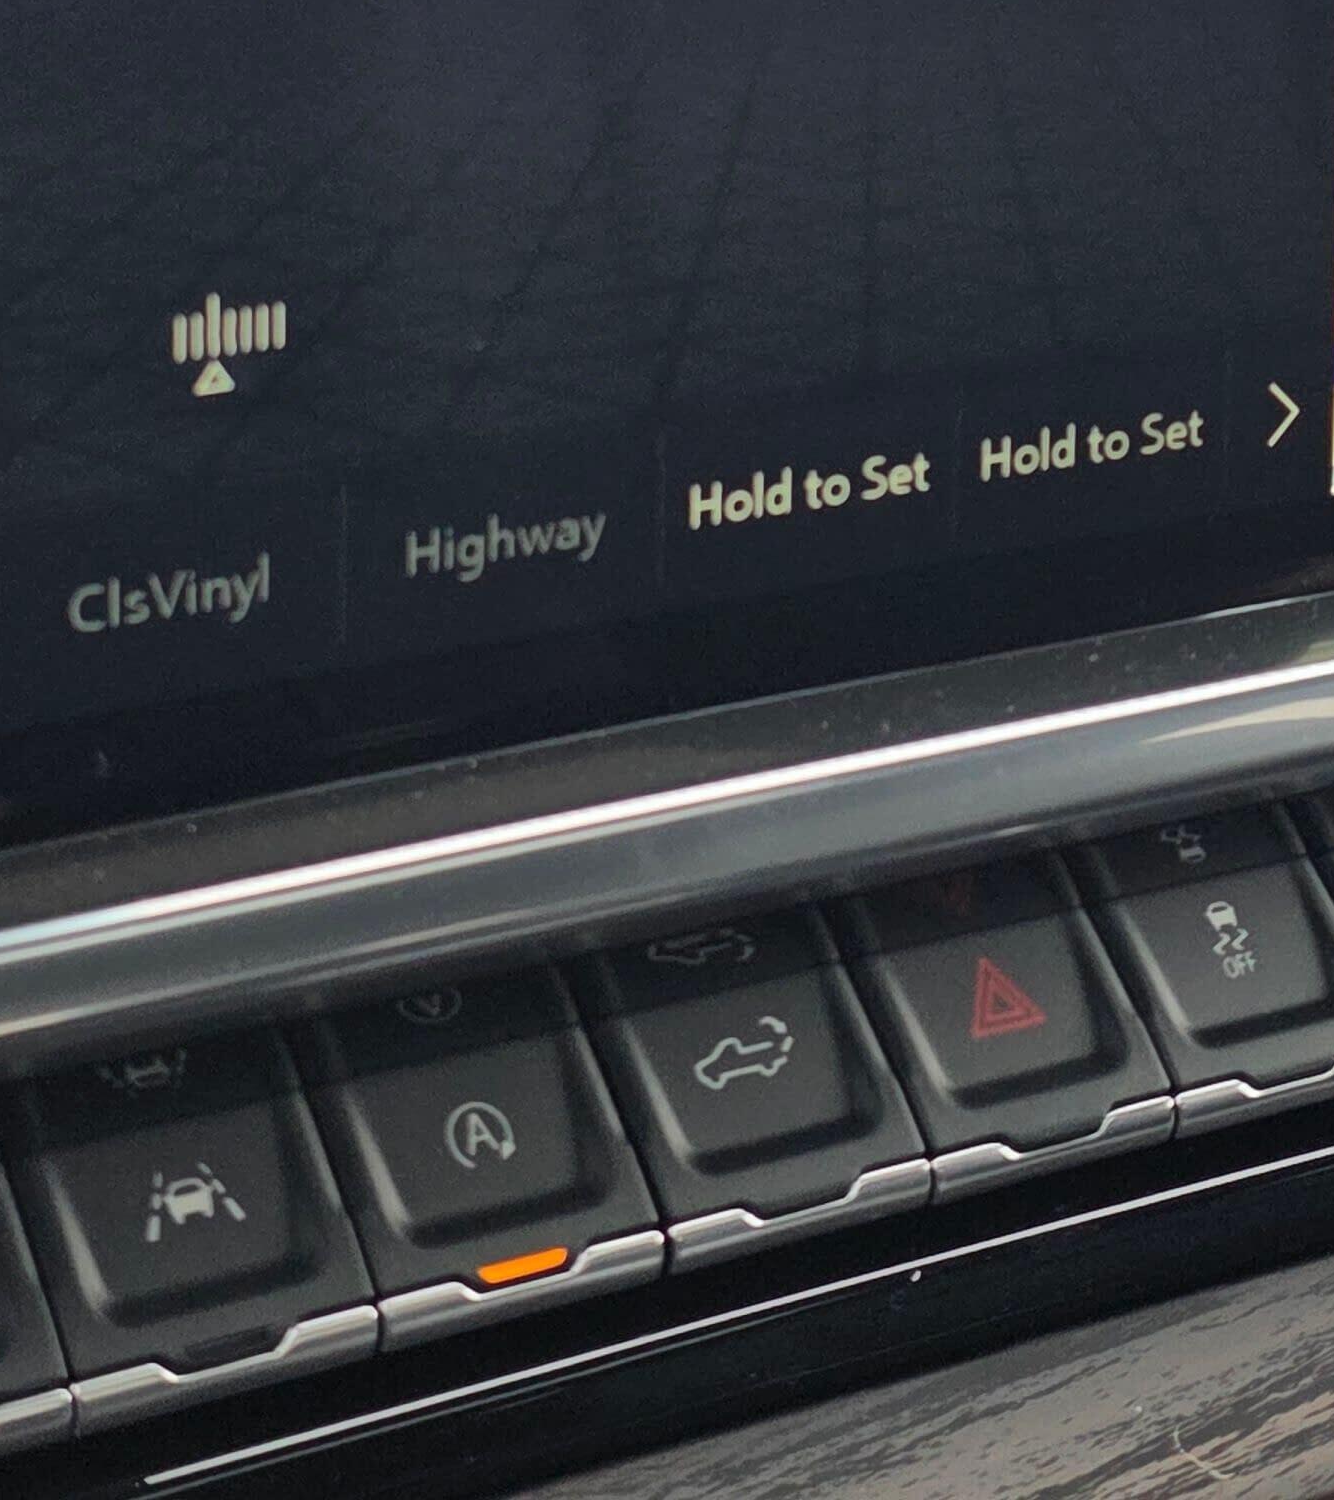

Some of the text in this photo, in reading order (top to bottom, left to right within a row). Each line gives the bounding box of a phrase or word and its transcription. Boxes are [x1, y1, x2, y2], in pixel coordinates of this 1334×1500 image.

[978, 408, 1206, 483] Hold to Set
[688, 451, 932, 531] Hold to Set
[405, 509, 607, 583] Highway
[67, 550, 271, 634] ClsVinyl
[1223, 952, 1258, 979] OFF
